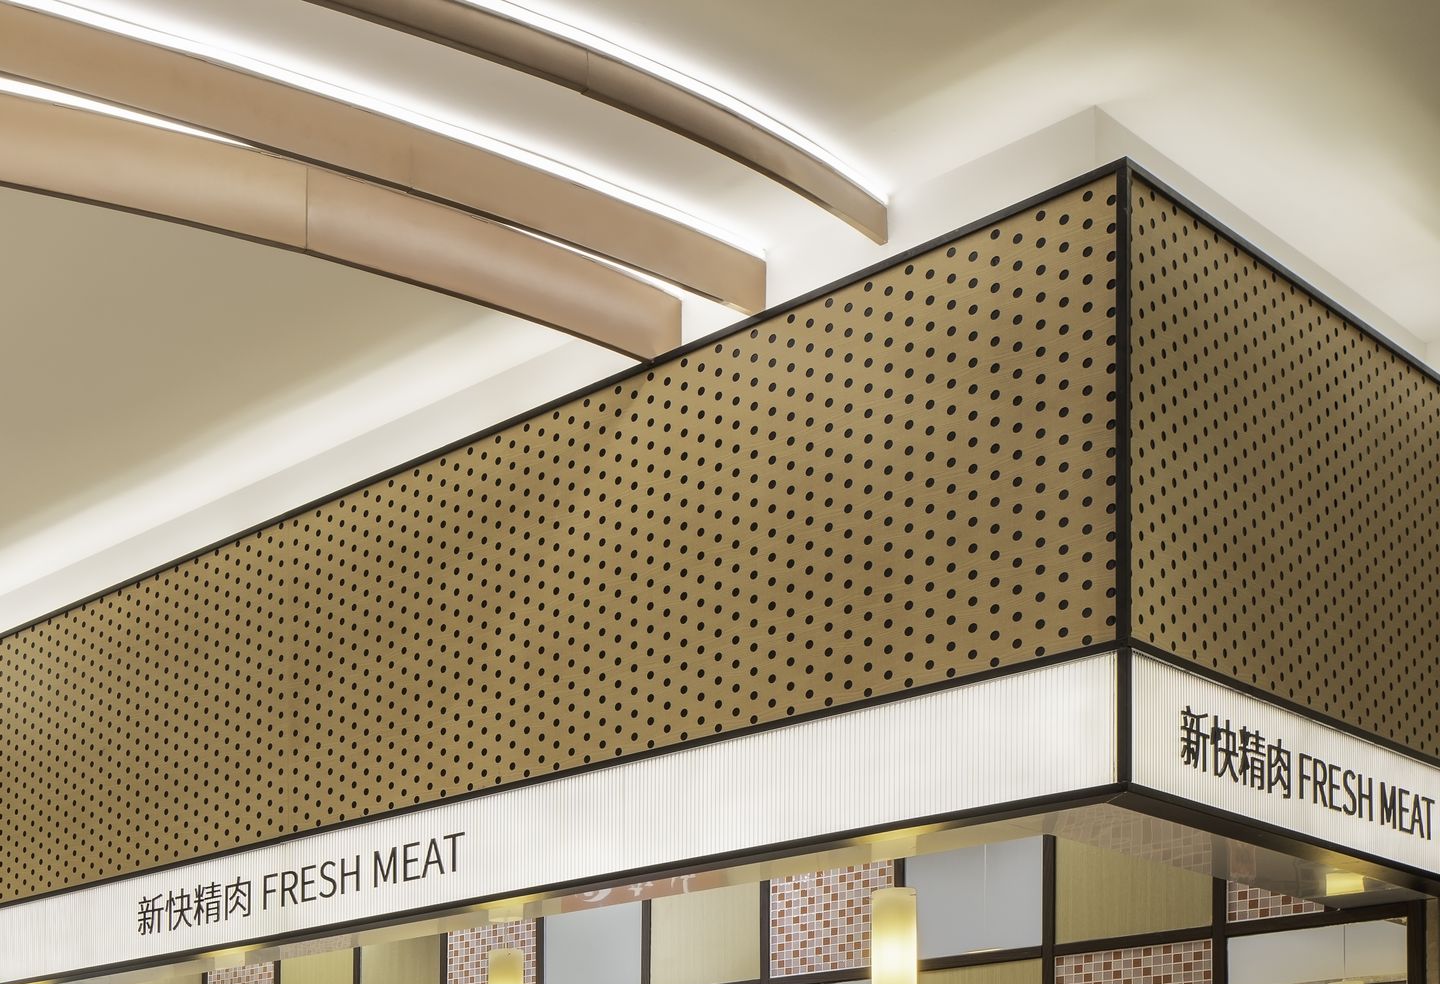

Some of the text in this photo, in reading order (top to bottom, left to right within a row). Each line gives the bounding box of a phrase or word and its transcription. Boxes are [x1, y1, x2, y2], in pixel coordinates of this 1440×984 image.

[1180, 705, 1435, 840] 新快精肉 FRESH MEAT
[137, 831, 466, 936] 新快精肉 FRESH MEAT
